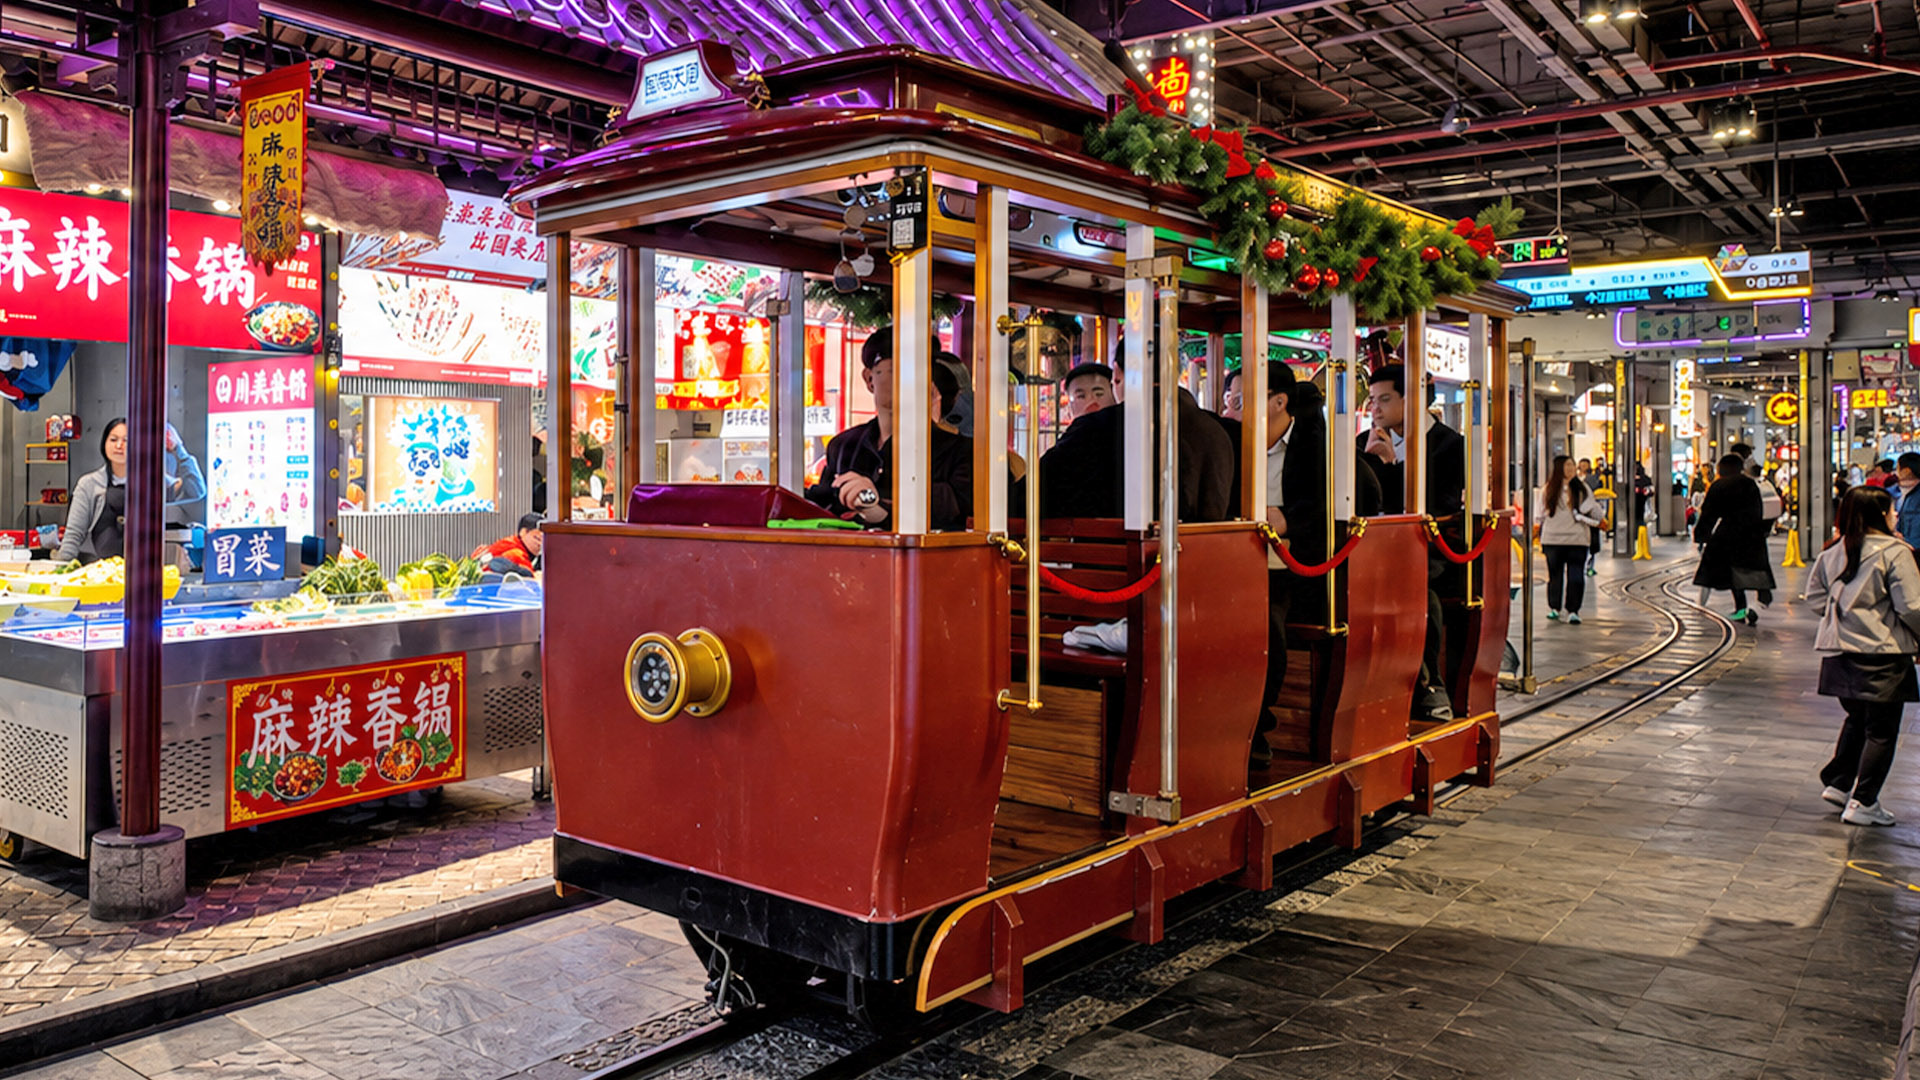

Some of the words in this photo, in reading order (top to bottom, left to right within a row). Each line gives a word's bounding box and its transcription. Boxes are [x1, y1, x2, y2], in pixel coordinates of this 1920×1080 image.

[0, 206, 256, 308] 麻辣锅
[212, 530, 281, 578] 冒菜
[247, 681, 451, 769] 麻辣香锅
